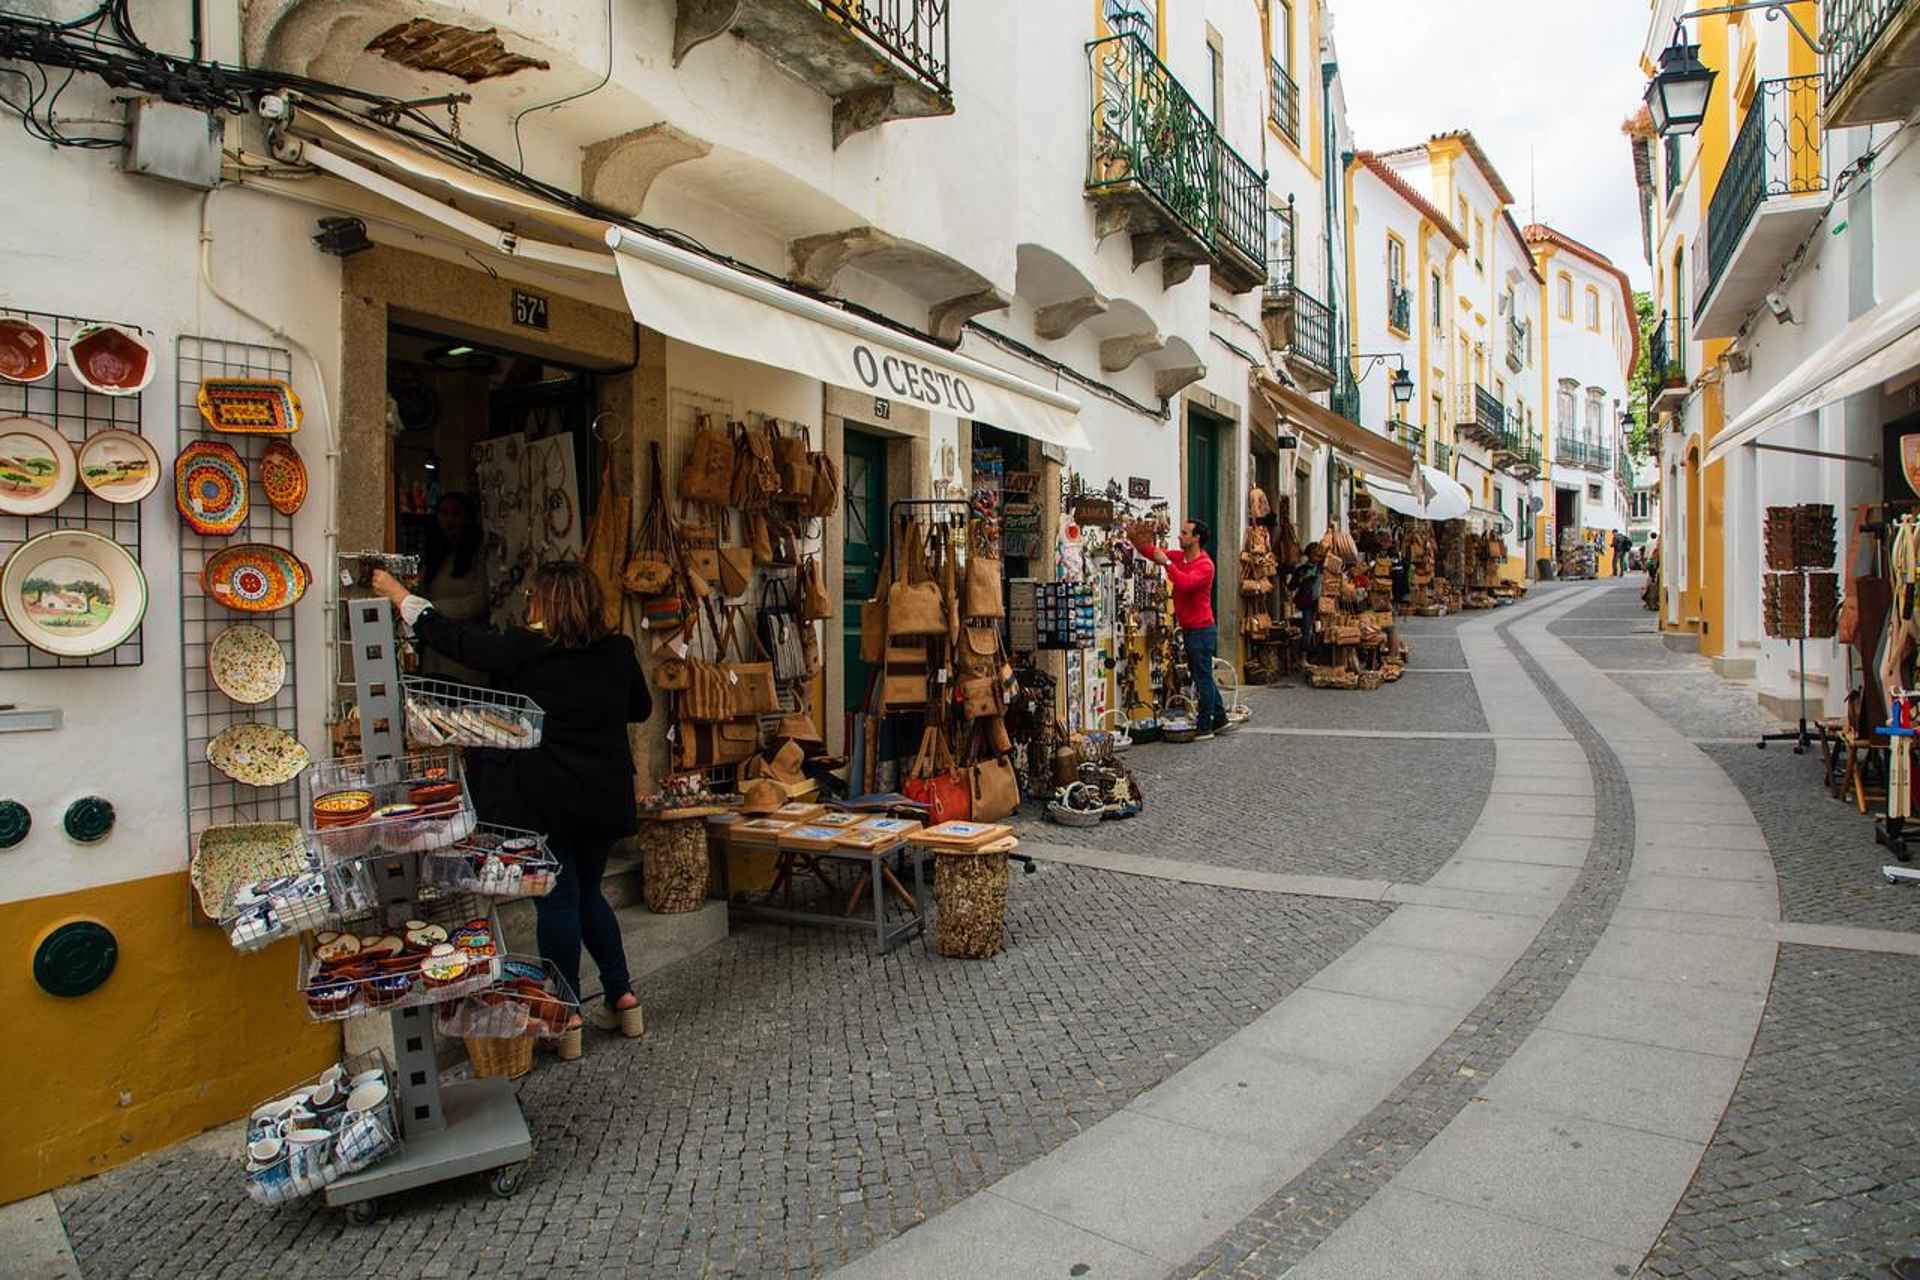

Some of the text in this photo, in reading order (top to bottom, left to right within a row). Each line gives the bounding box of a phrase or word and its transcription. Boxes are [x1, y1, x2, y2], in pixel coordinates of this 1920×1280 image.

[853, 345, 975, 413] O CESTO
[876, 401, 889, 417] 57
